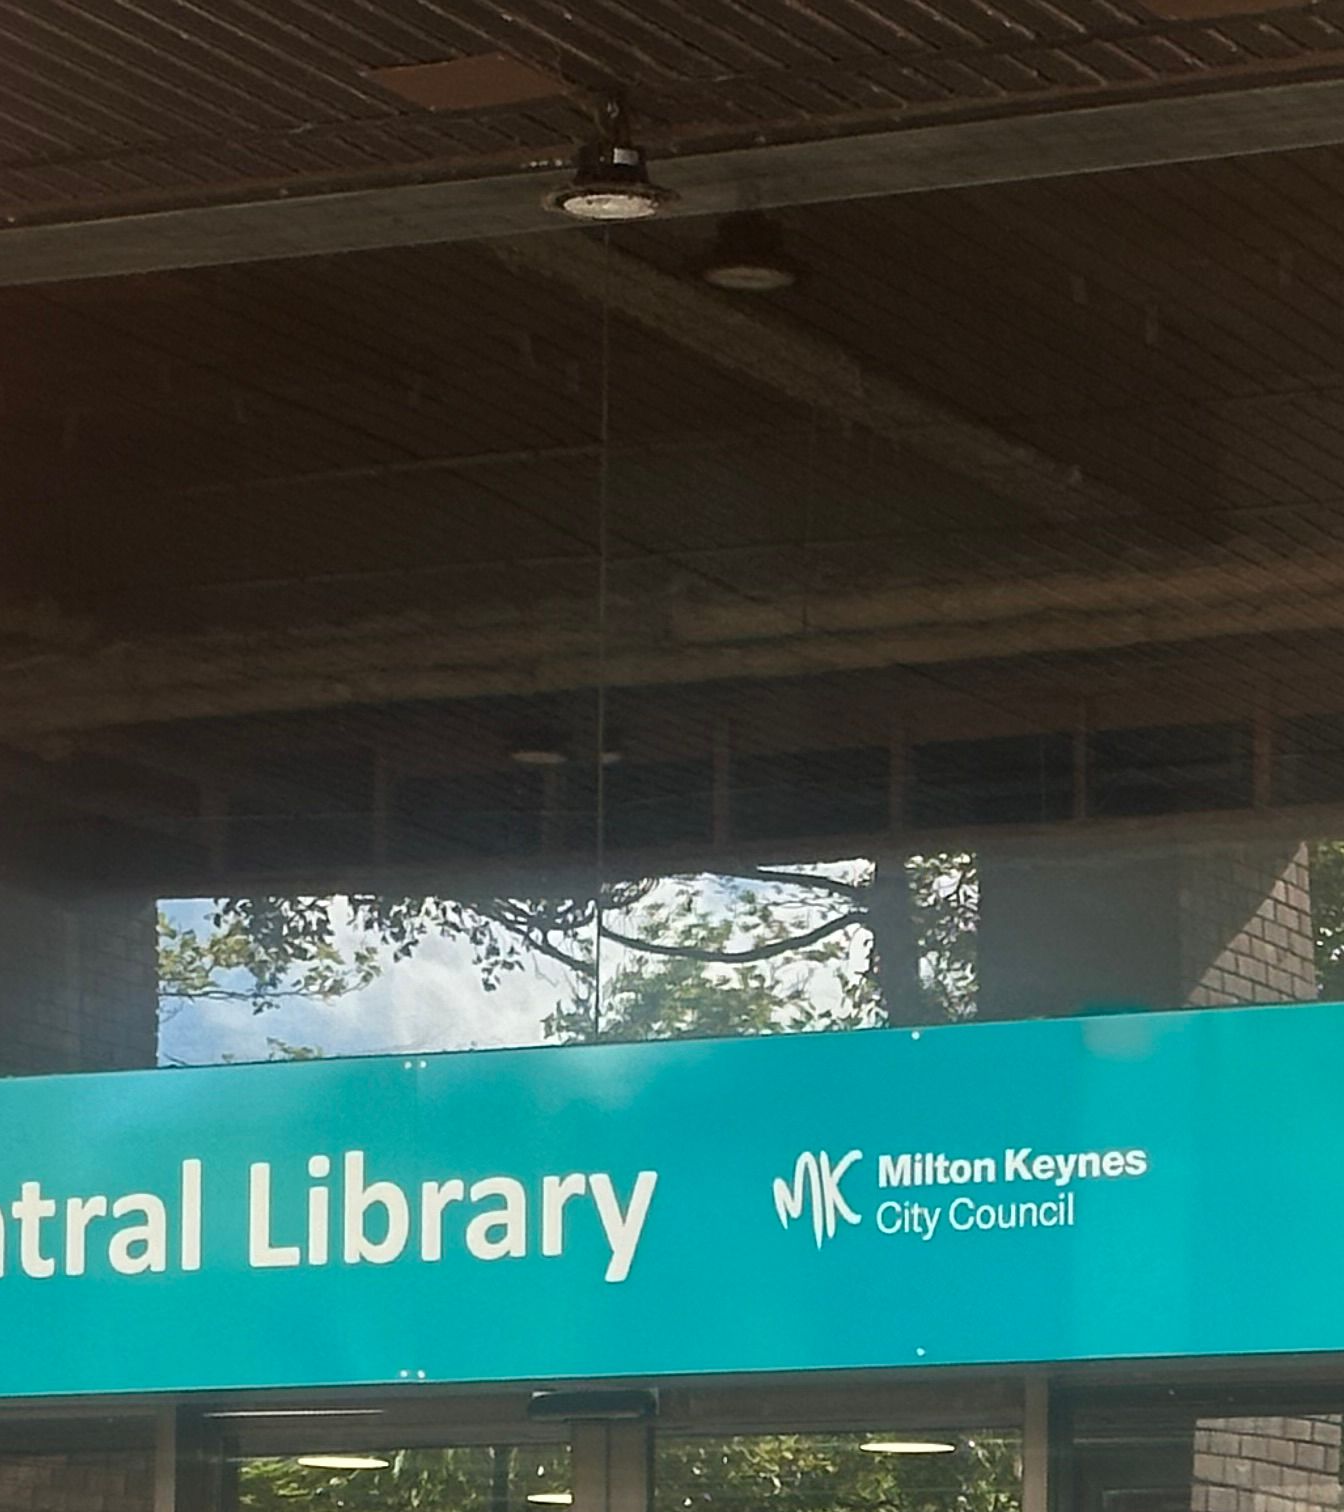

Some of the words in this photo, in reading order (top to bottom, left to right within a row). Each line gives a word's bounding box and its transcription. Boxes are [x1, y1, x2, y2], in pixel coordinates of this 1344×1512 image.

[878, 1153, 996, 1188] Milton
[1004, 1148, 1148, 1187] Keynes
[248, 1149, 658, 1283] Library
[876, 1201, 941, 1241] City
[949, 1192, 1075, 1231] Council
